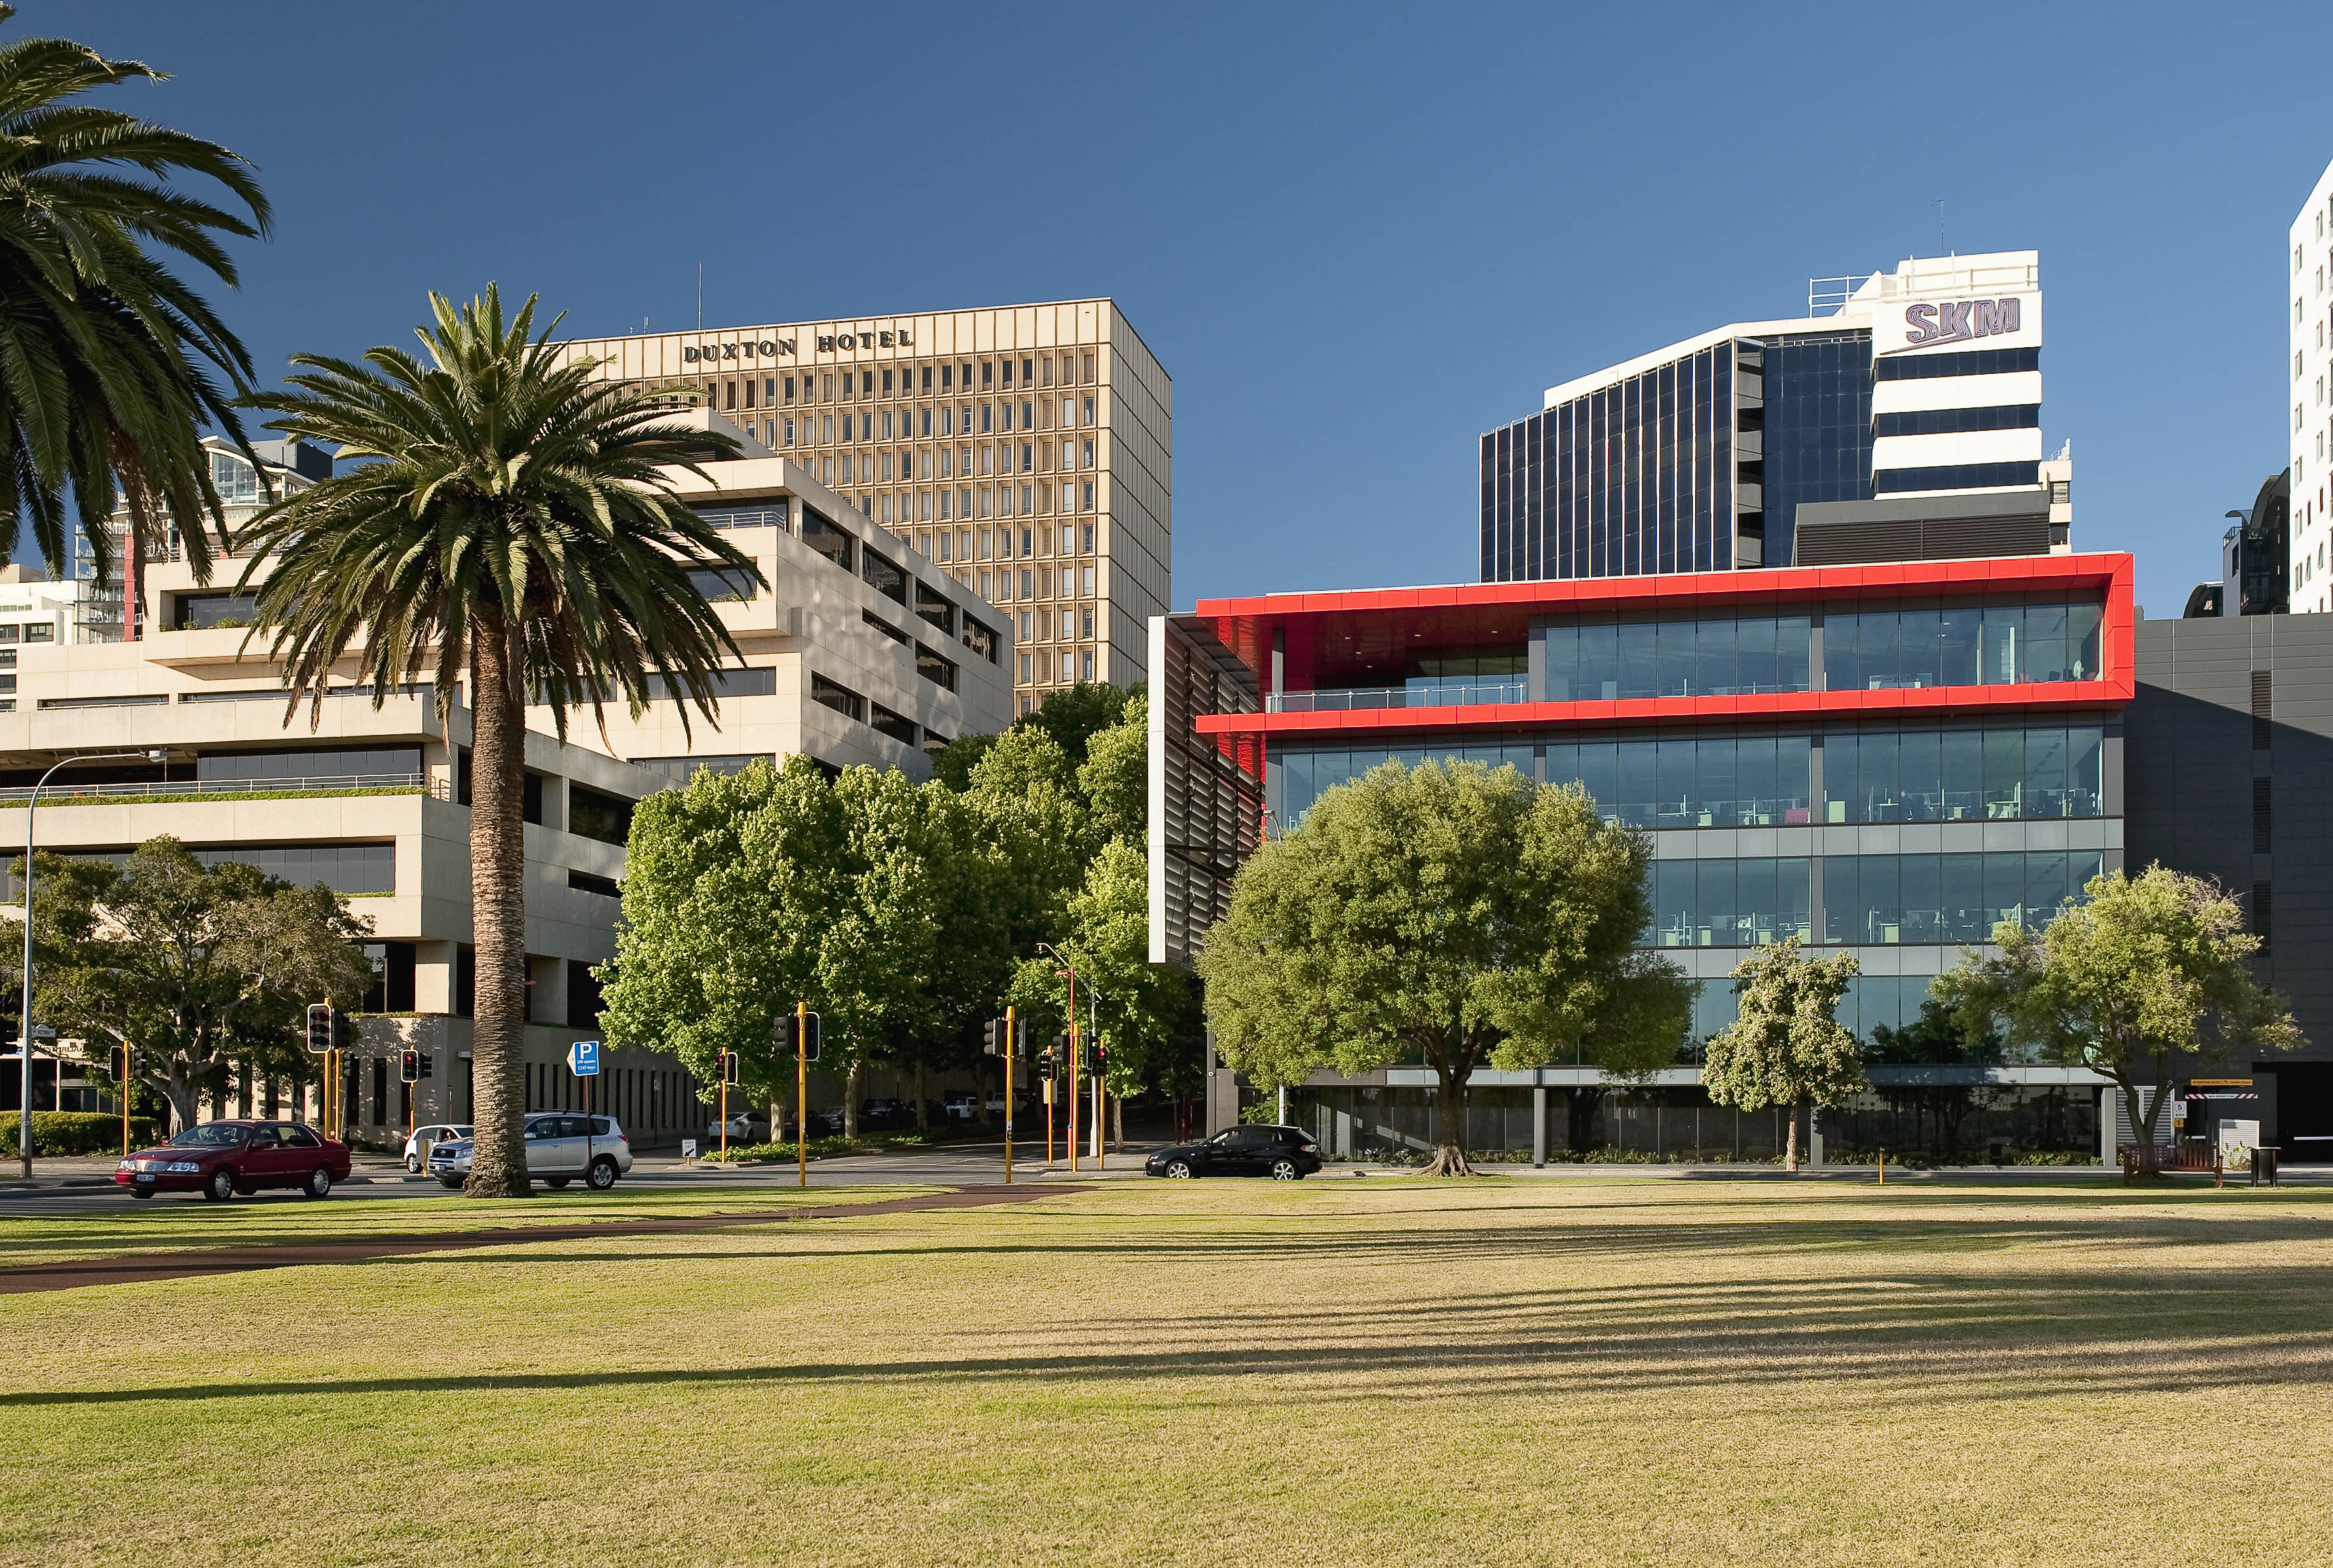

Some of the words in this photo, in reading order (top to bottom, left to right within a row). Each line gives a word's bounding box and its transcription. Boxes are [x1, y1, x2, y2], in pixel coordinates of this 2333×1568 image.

[1906, 298, 2021, 343] SKM
[684, 337, 796, 363] DUXTON
[817, 329, 914, 353] HOTEL
[580, 1043, 592, 1059] P
